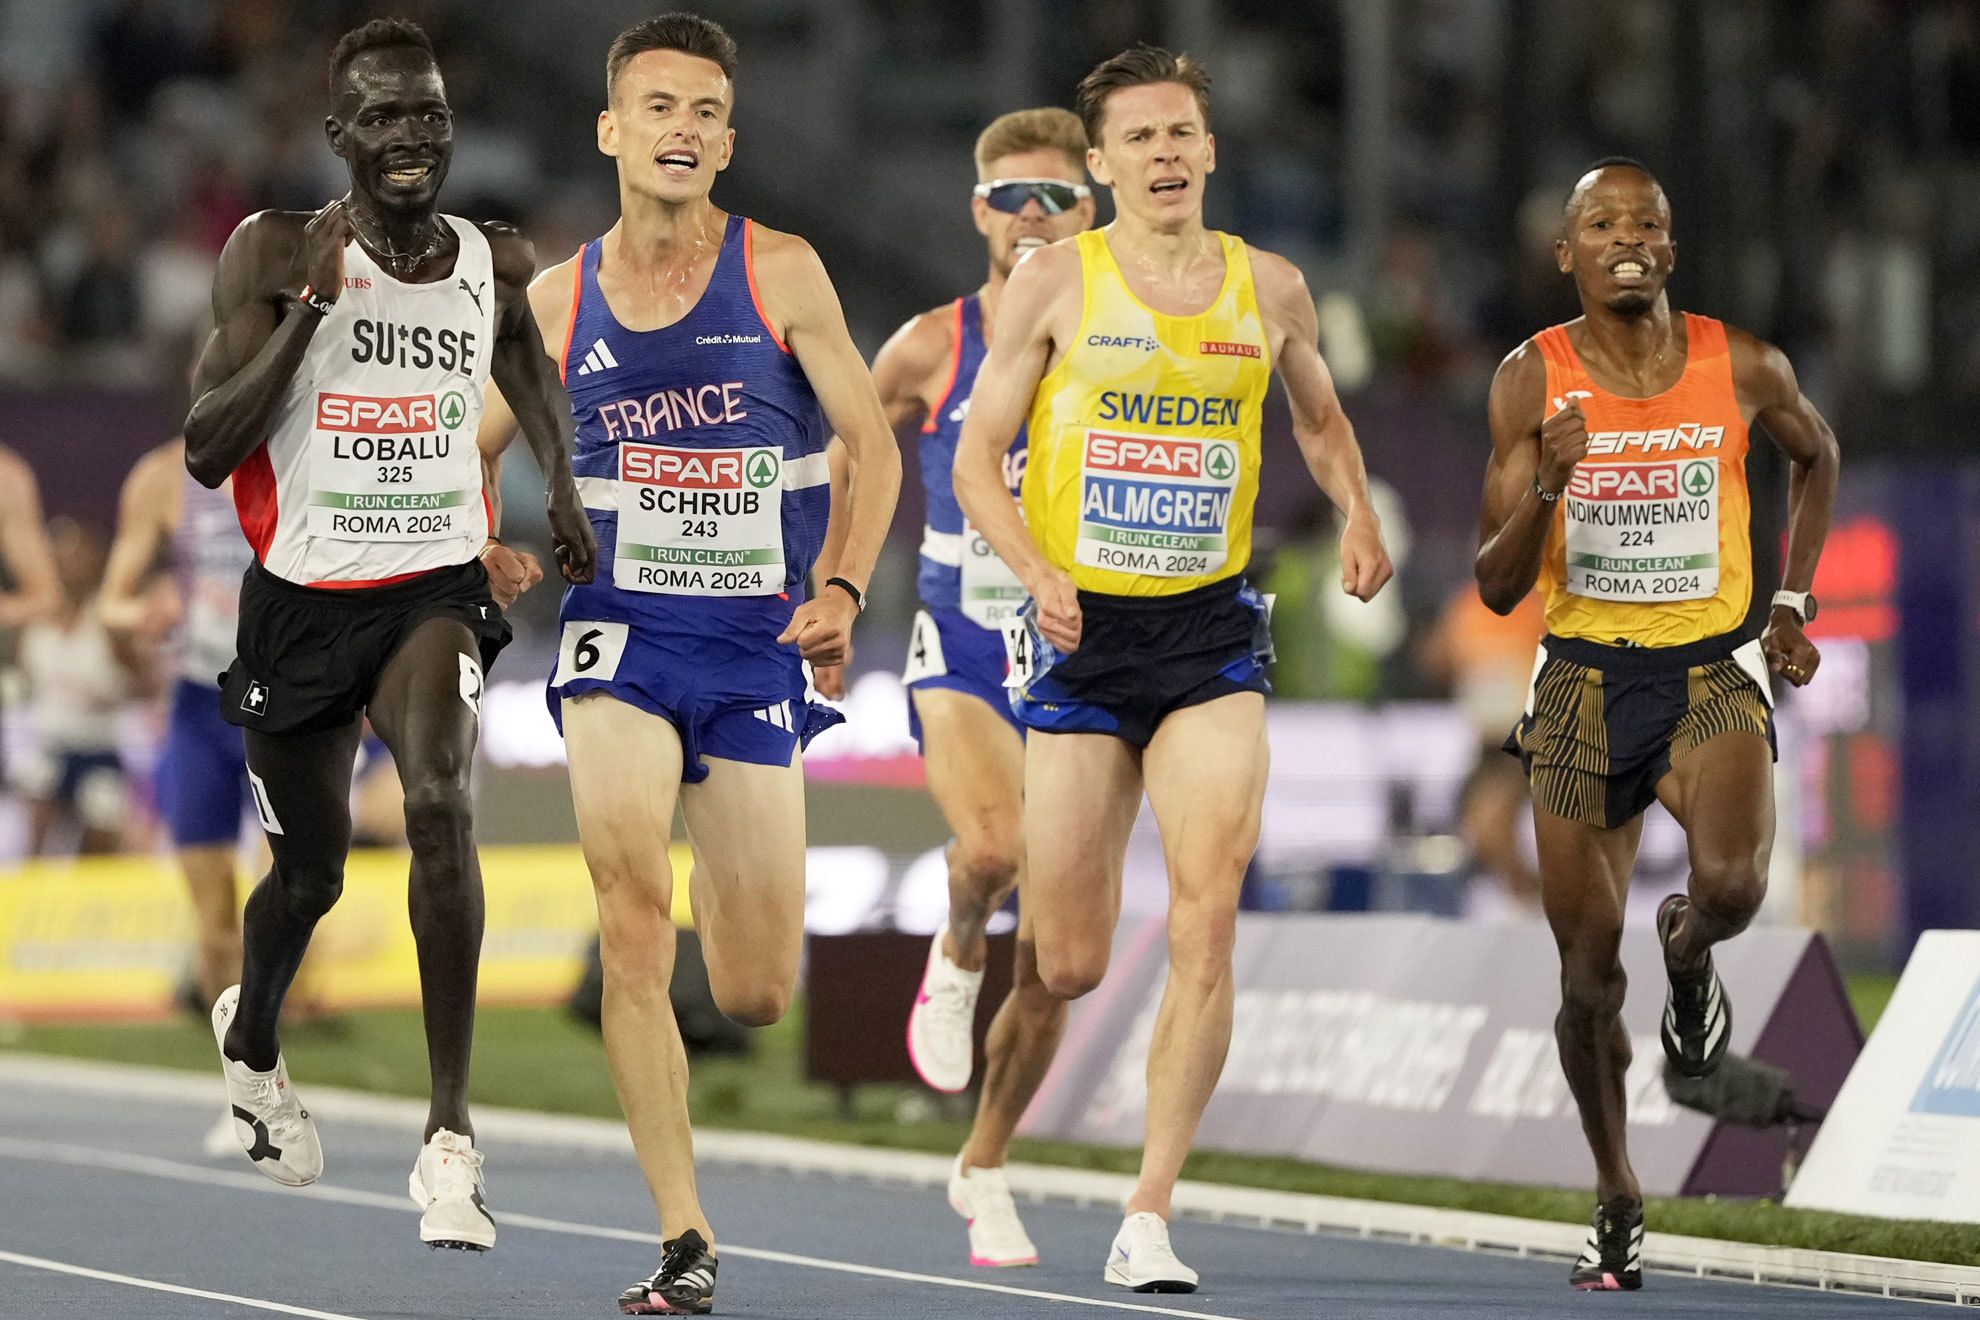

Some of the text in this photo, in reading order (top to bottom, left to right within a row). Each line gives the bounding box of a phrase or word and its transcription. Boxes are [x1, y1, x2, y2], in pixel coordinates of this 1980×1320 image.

[344, 277, 372, 289] UBS
[695, 334, 761, 345] Crédit Mutuel
[1088, 335, 1144, 349] CRAFT
[1200, 342, 1261, 358] BAUHAUS
[321, 399, 434, 428] SPAR
[597, 382, 748, 441] FRANCE
[1098, 391, 1242, 427] SWEDEN
[333, 434, 450, 461] LOBALU
[1089, 438, 1199, 473] SPAR
[377, 466, 413, 483] 325
[626, 452, 740, 484] SPAR
[1570, 469, 1675, 497] SPAR
[345, 495, 350, 508] I
[353, 495, 388, 508] RUN
[639, 487, 760, 516] SCHRUB
[1085, 483, 1229, 528] ALMGREN
[1567, 499, 1710, 526] NDIKUMWENAYO
[333, 513, 451, 534] ROMA 2024
[681, 520, 719, 538] 243
[1109, 530, 1114, 542] I
[1116, 531, 1150, 546] RUN
[1620, 530, 1655, 547] 224
[650, 547, 655, 560] I
[657, 548, 692, 563] RUN
[1097, 547, 1208, 572] ROMA 2024
[1594, 557, 1599, 569] I
[1600, 558, 1633, 571] RUN
[638, 566, 763, 590] ROMA 2024
[1585, 573, 1700, 594] ROMA 2024
[574, 629, 604, 673] 6
[915, 623, 927, 668] 4
[1010, 629, 1028, 676] 14
